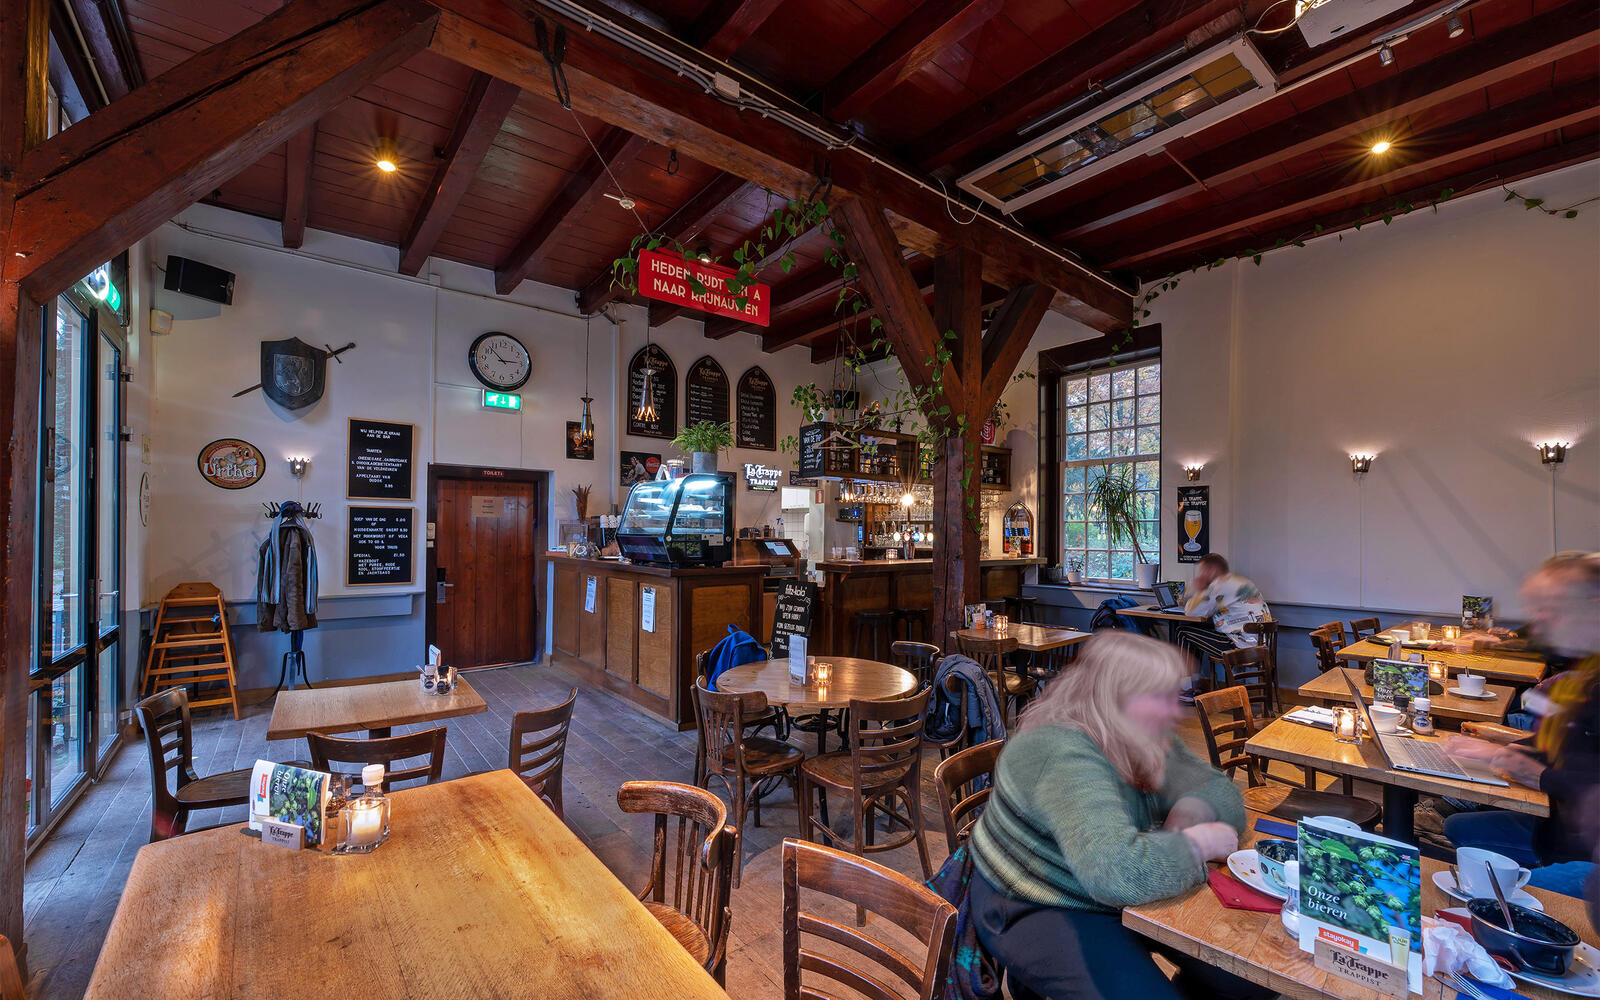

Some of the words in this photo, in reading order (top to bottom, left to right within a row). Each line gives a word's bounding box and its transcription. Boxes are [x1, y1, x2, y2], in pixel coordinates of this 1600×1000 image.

[652, 259, 691, 280] HEDEN
[654, 278, 686, 298] NAAR
[204, 462, 257, 478] Urthel
[744, 464, 755, 479] La
[755, 465, 782, 478] Trappe
[1308, 885, 1341, 905] Onze
[1308, 898, 1348, 920] bieren
[1323, 931, 1354, 947] stayokay
[1330, 949, 1346, 966] La
[1345, 955, 1389, 979] Trappe
[1338, 967, 1381, 986] TRAPPIST
